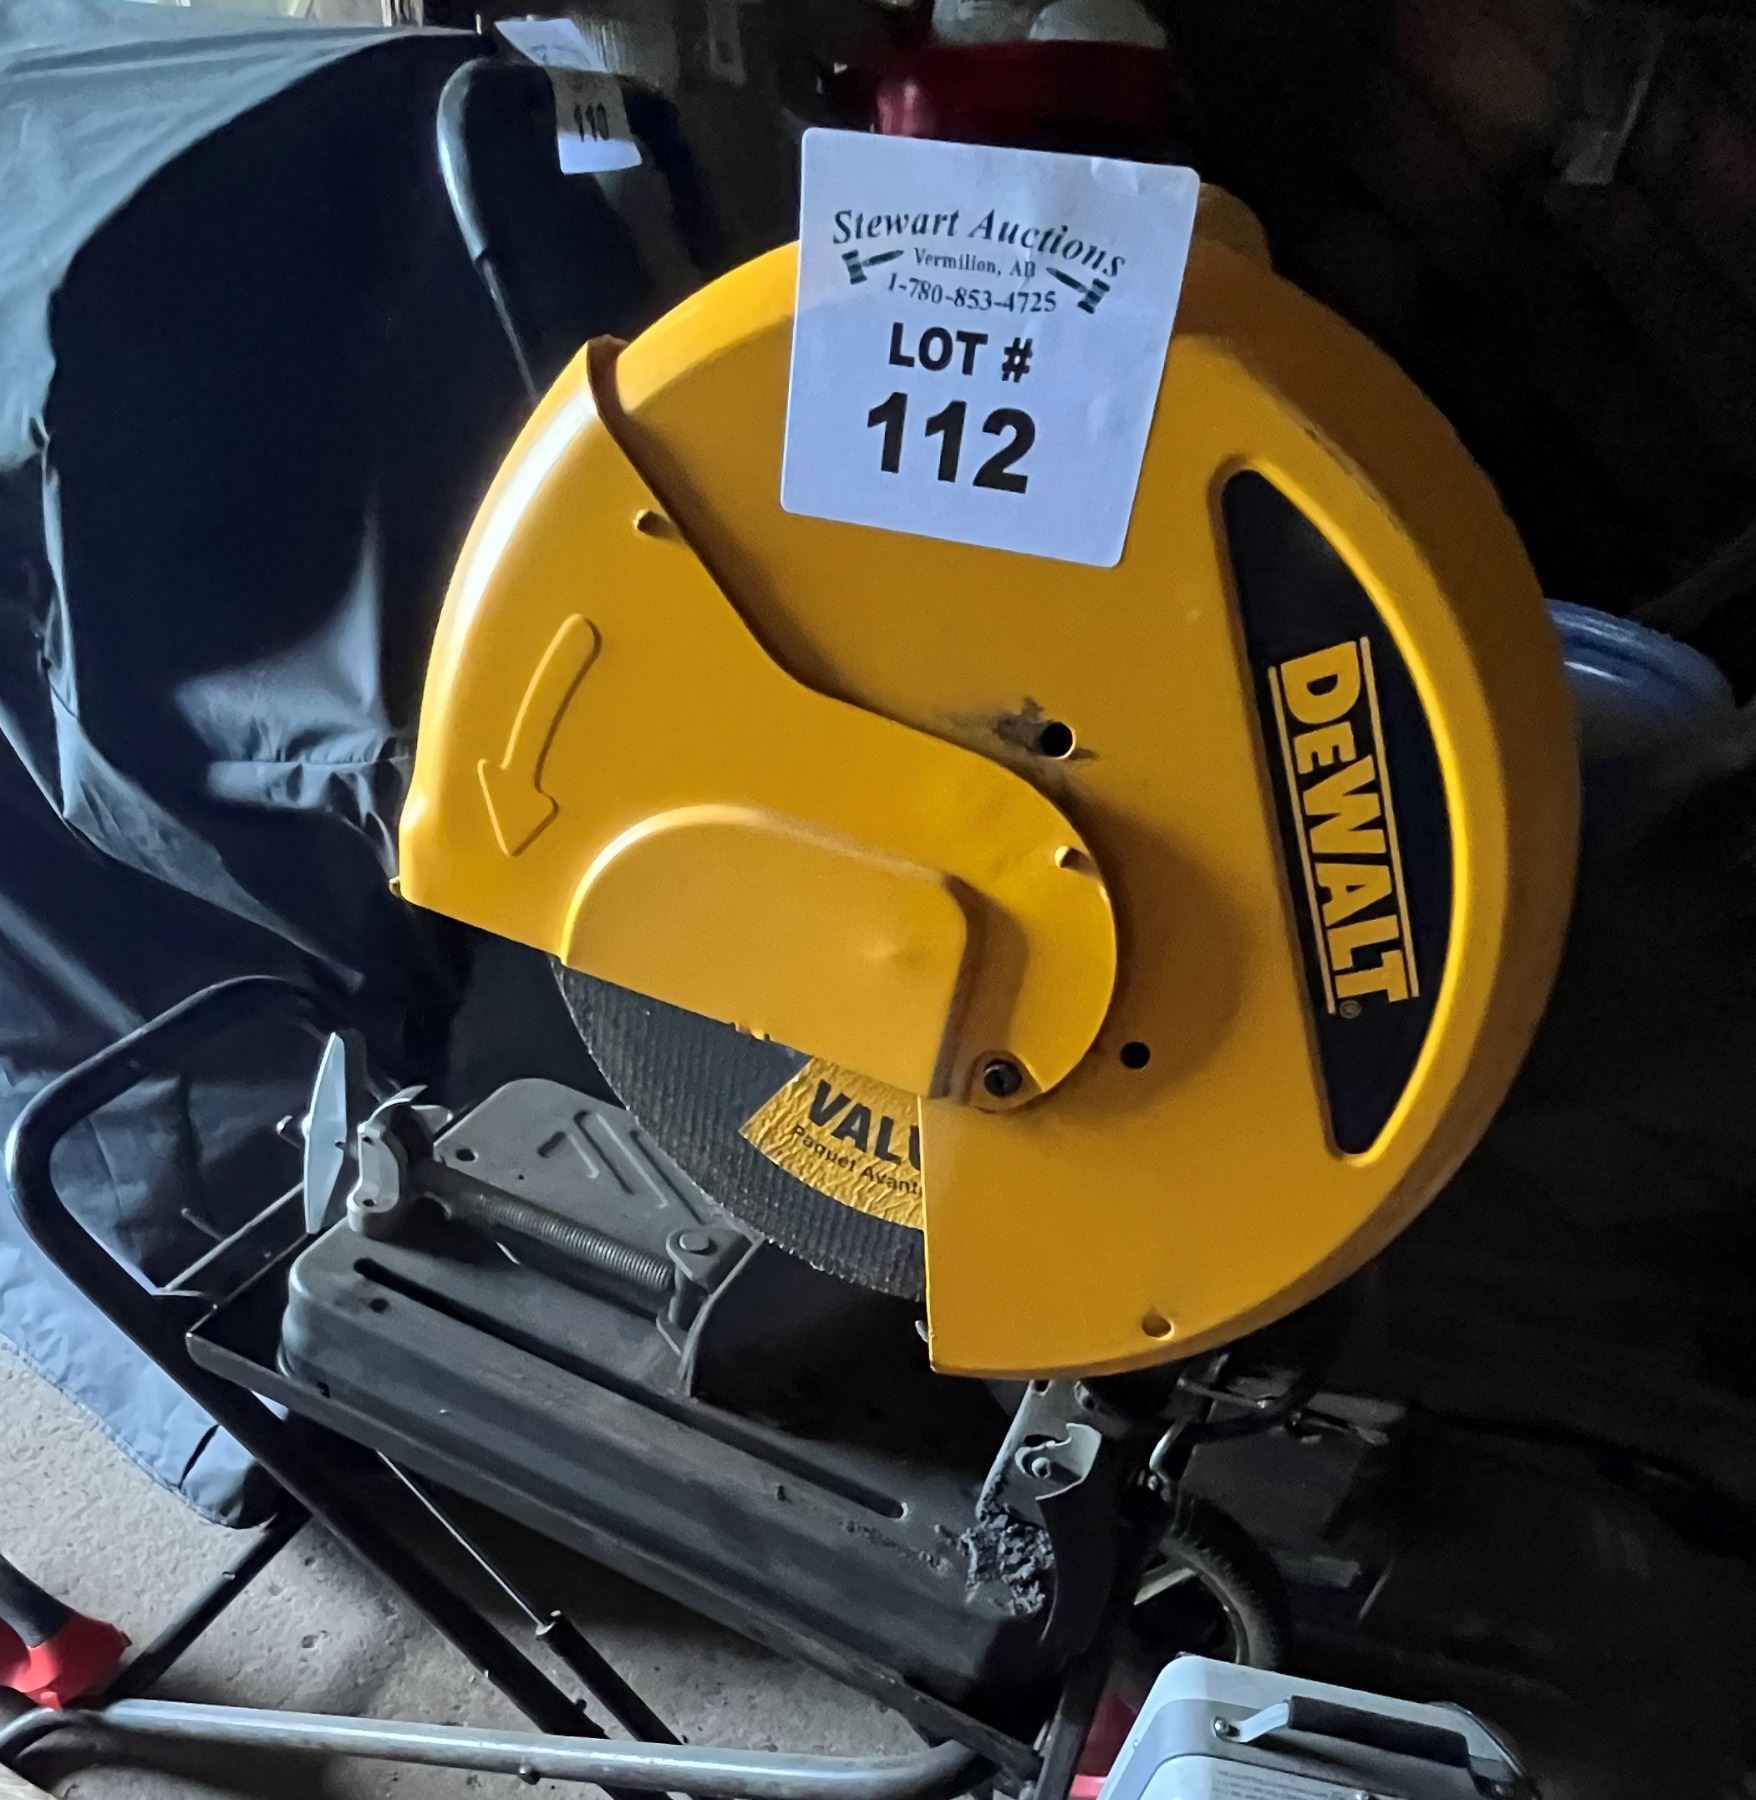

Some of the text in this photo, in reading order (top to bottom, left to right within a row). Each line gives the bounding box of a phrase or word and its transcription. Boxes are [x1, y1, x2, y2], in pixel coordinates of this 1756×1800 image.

[574, 103, 610, 143] 110
[833, 208, 1126, 278] Stewart Auctions
[913, 247, 1037, 278] Vermilion, AB
[887, 272, 1057, 314] 1-780-853-4725
[888, 321, 1034, 384] LOT #
[867, 391, 1037, 495] 112
[791, 1122, 923, 1197] Paquet Avant
